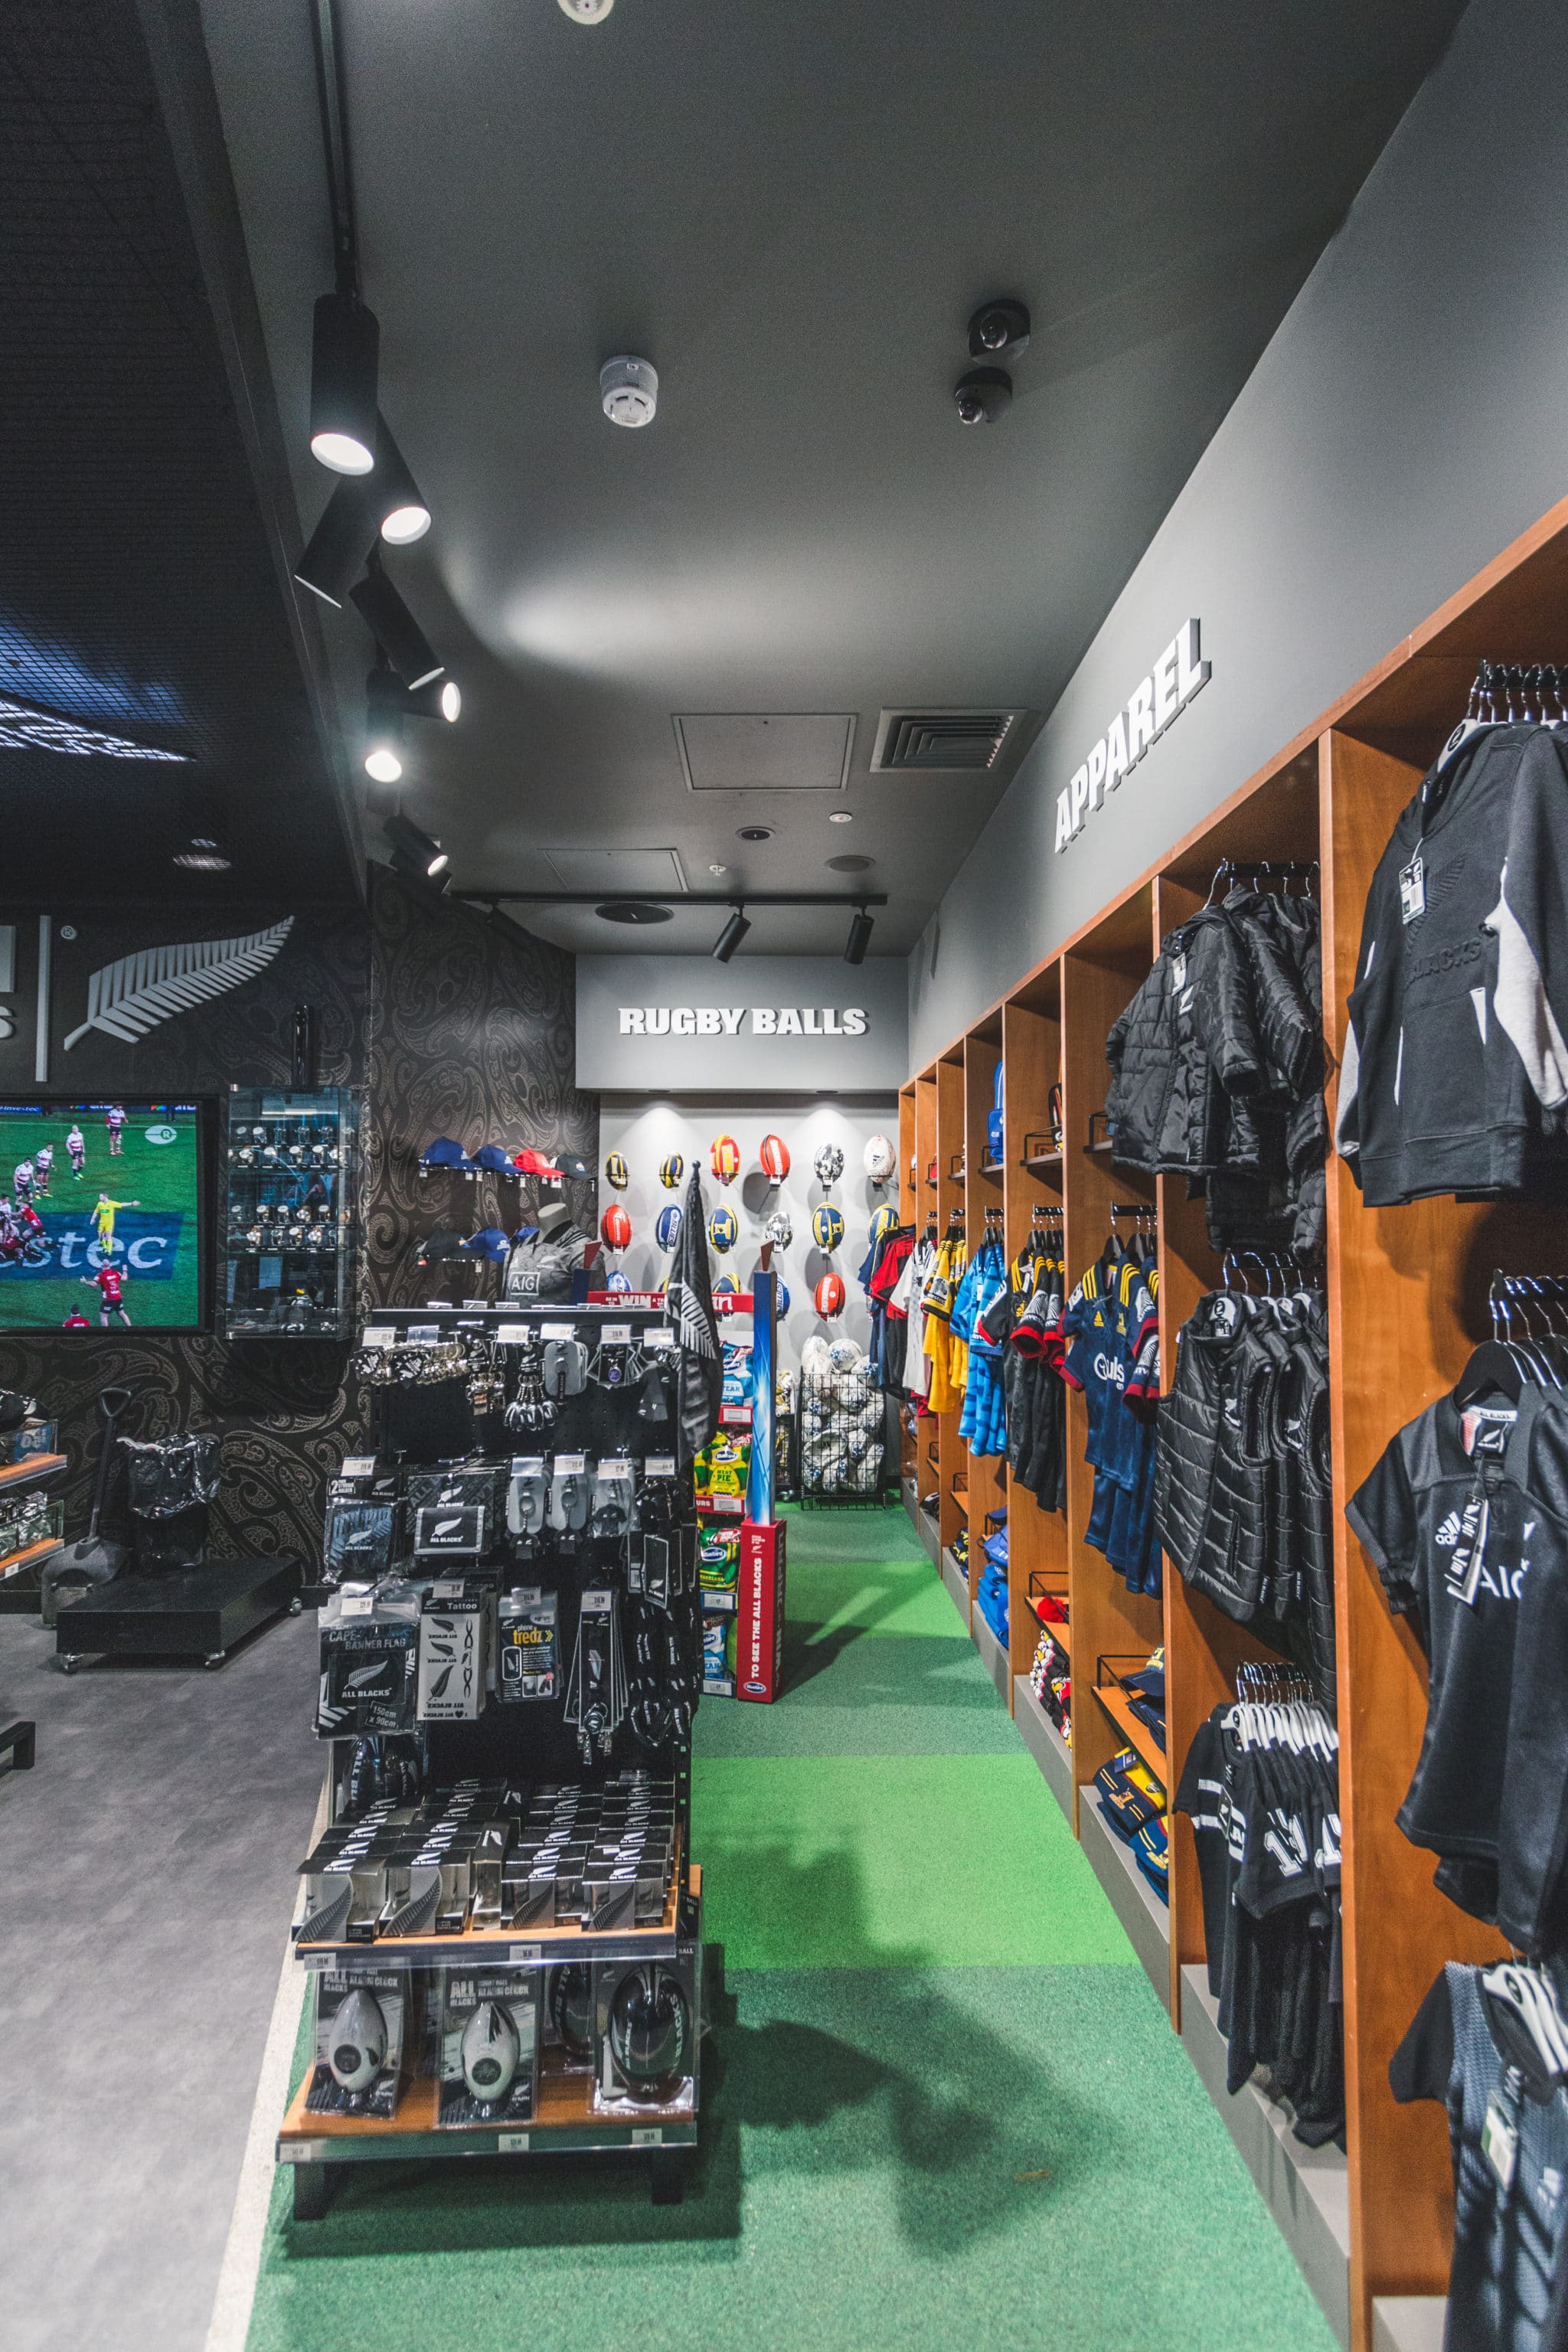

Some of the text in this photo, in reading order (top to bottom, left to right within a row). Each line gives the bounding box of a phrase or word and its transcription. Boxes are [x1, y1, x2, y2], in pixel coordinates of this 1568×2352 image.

[1055, 617, 1211, 854] APPAREL
[619, 1007, 870, 1036] RUGBY BALLS
[510, 1276, 536, 1292] AIG
[619, 1295, 651, 1309] WIN
[331, 1479, 338, 1496] 2
[753, 1557, 763, 1599] BLACKS
[753, 1599, 761, 1619] ALL
[513, 1627, 543, 1645] tredz
[753, 1619, 761, 1641] THE
[345, 1638, 406, 1651] BANNER FLAG
[751, 1664, 760, 1678] TO
[358, 1689, 390, 1697] BLACKS
[373, 1706, 397, 1718] 150cm
[376, 1716, 397, 1728] 90cm
[352, 1751, 363, 1775] ALL
[374, 1977, 398, 1987] CLOCK
[450, 1981, 476, 1998] ALL
[505, 1985, 529, 1995] CLOCK
[449, 1998, 476, 2007] BLACKS
[671, 1993, 683, 2058] BLACKS
